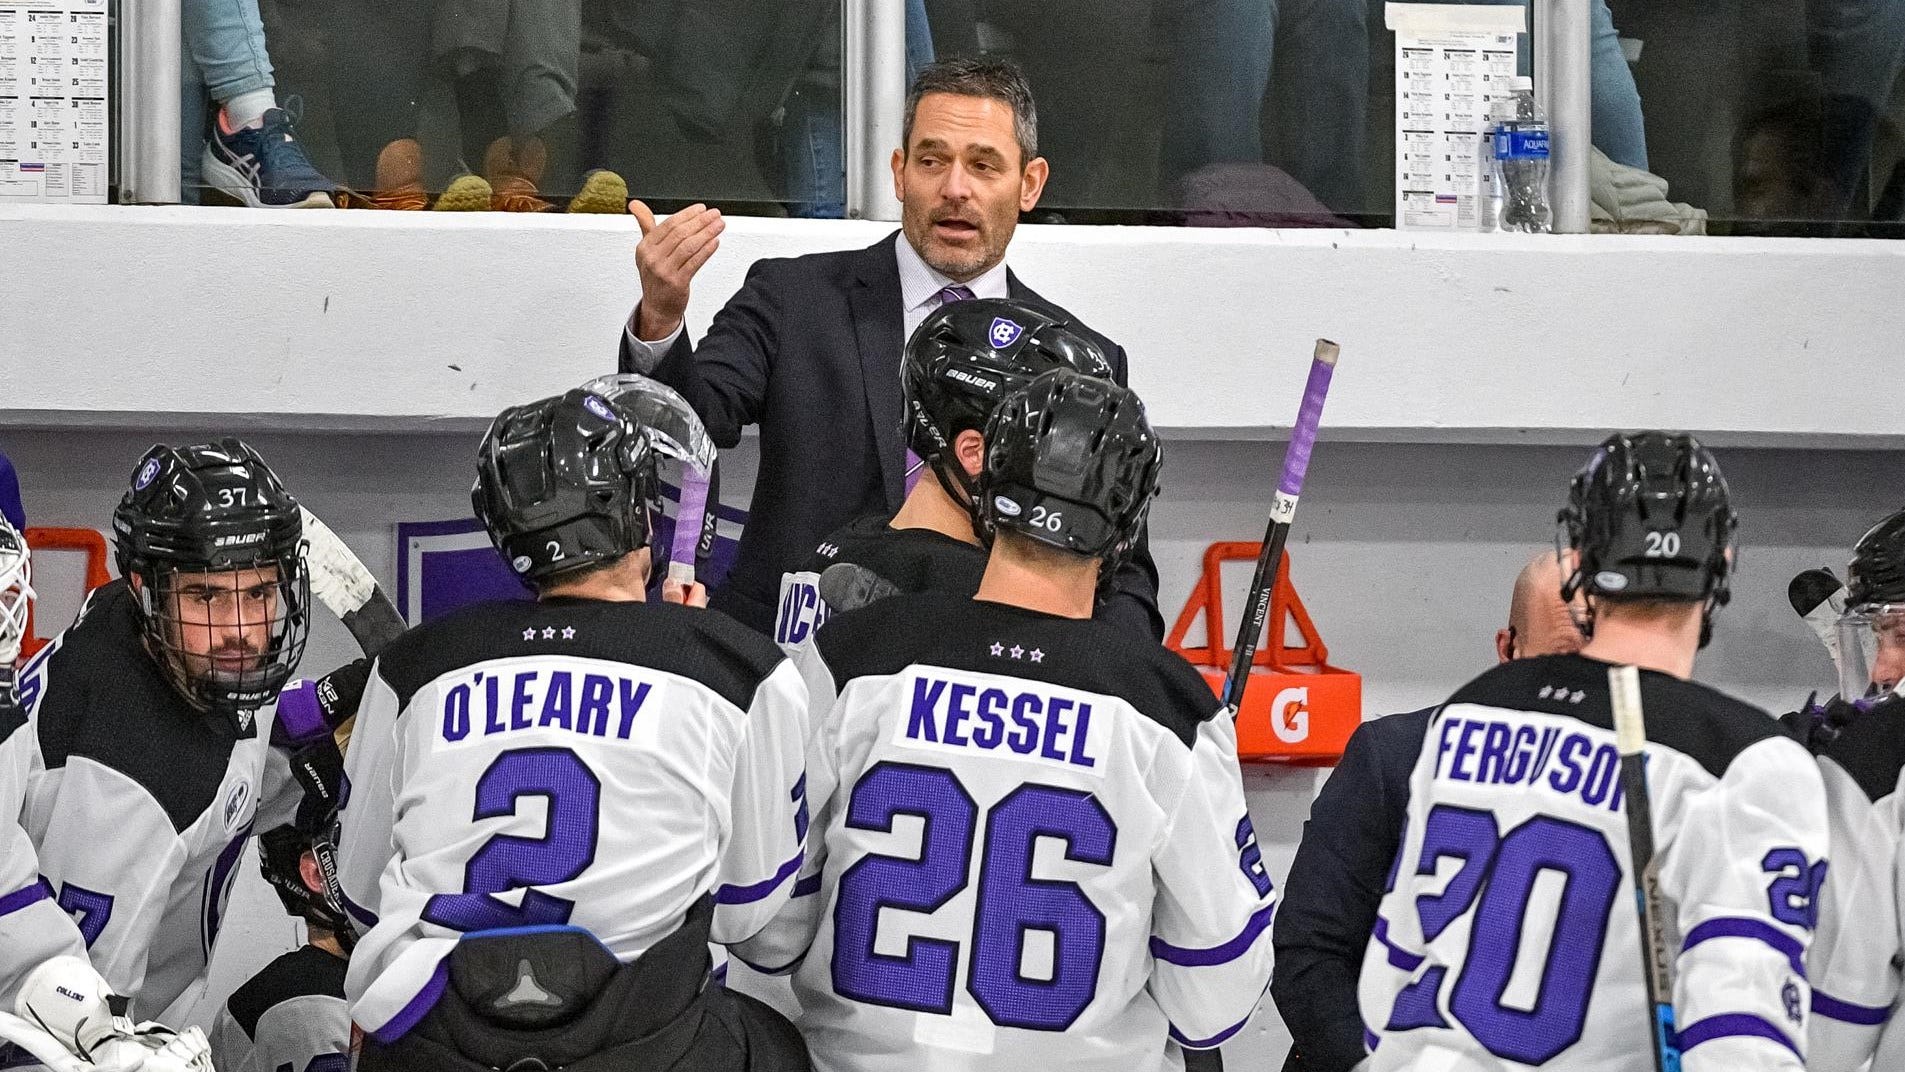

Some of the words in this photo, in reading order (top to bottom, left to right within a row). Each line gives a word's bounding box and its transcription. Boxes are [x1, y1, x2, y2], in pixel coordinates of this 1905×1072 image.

[28, 14, 36, 22] 24
[30, 56, 37, 64] 12
[31, 77, 36, 85] 11
[72, 78, 79, 86] 25
[74, 121, 77, 129] 1
[946, 368, 997, 391] BAUER
[218, 487, 247, 507] 37
[1028, 505, 1063, 532] 26
[214, 532, 266, 547] BAUER
[546, 540, 565, 562] 2
[1644, 531, 1681, 557] 20
[1252, 587, 1271, 628] VINCENT
[442, 671, 653, 742] O'LEARY
[1270, 687, 1309, 744] G
[906, 676, 1096, 767] KESSEL
[420, 746, 601, 934] 2
[830, 760, 1118, 1032] 26
[1385, 803, 1622, 1066] 20
[56, 985, 85, 1002] COLLINS
